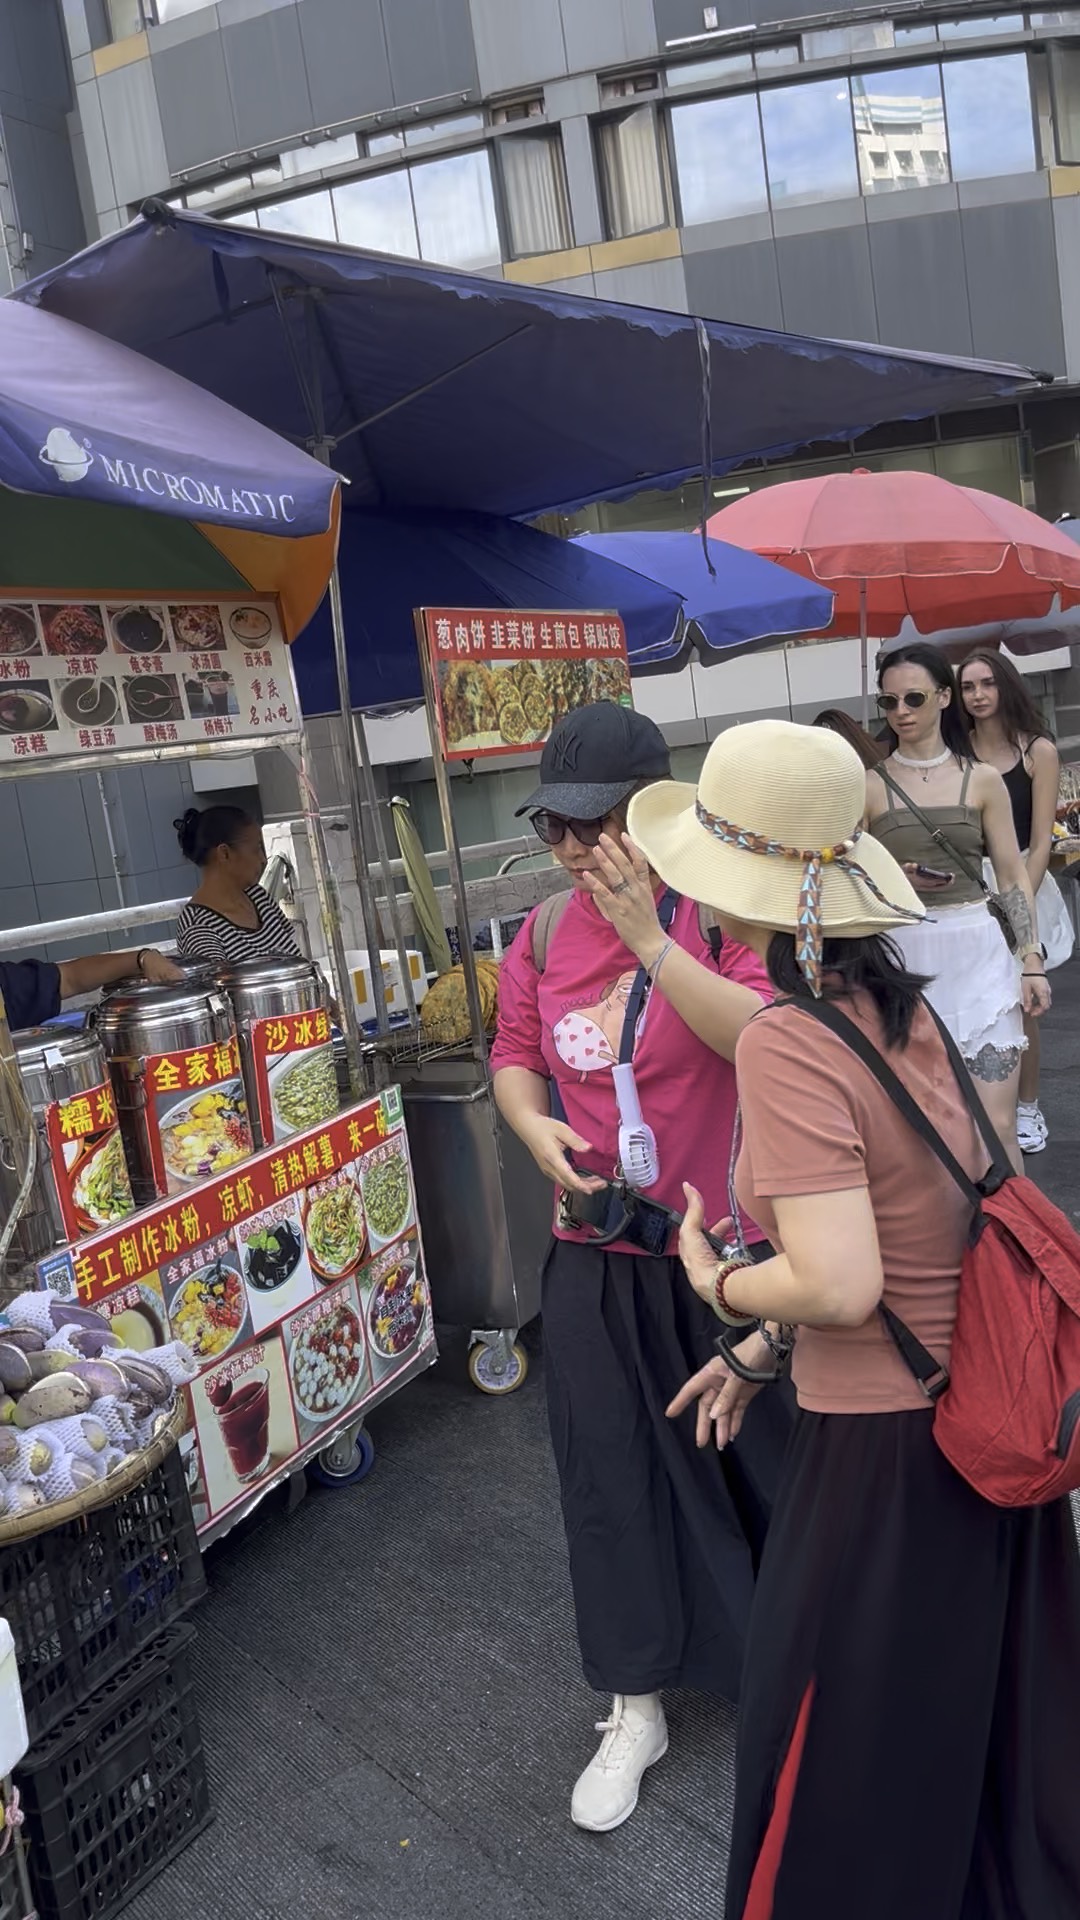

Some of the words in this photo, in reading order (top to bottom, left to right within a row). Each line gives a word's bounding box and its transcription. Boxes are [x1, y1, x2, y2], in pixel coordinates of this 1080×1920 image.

[99, 453, 296, 523] MICROMATIC
[435, 618, 486, 653] 葱肉饼
[490, 620, 535, 650] 韭菜饼
[540, 621, 581, 650] 生煎包
[583, 622, 621, 650] 锅贴饺
[65, 657, 99, 676] 凉虾
[129, 656, 164, 674] 龟苓膏
[251, 678, 280, 700] 重庆
[250, 703, 292, 726] 名小吃
[143, 723, 178, 742] 酸梅汤
[203, 716, 233, 736] 杨梅汁
[11, 733, 48, 755] 凉糕
[79, 728, 116, 748] 绿豆汤
[167, 1236, 229, 1284] 全家福冰粉
